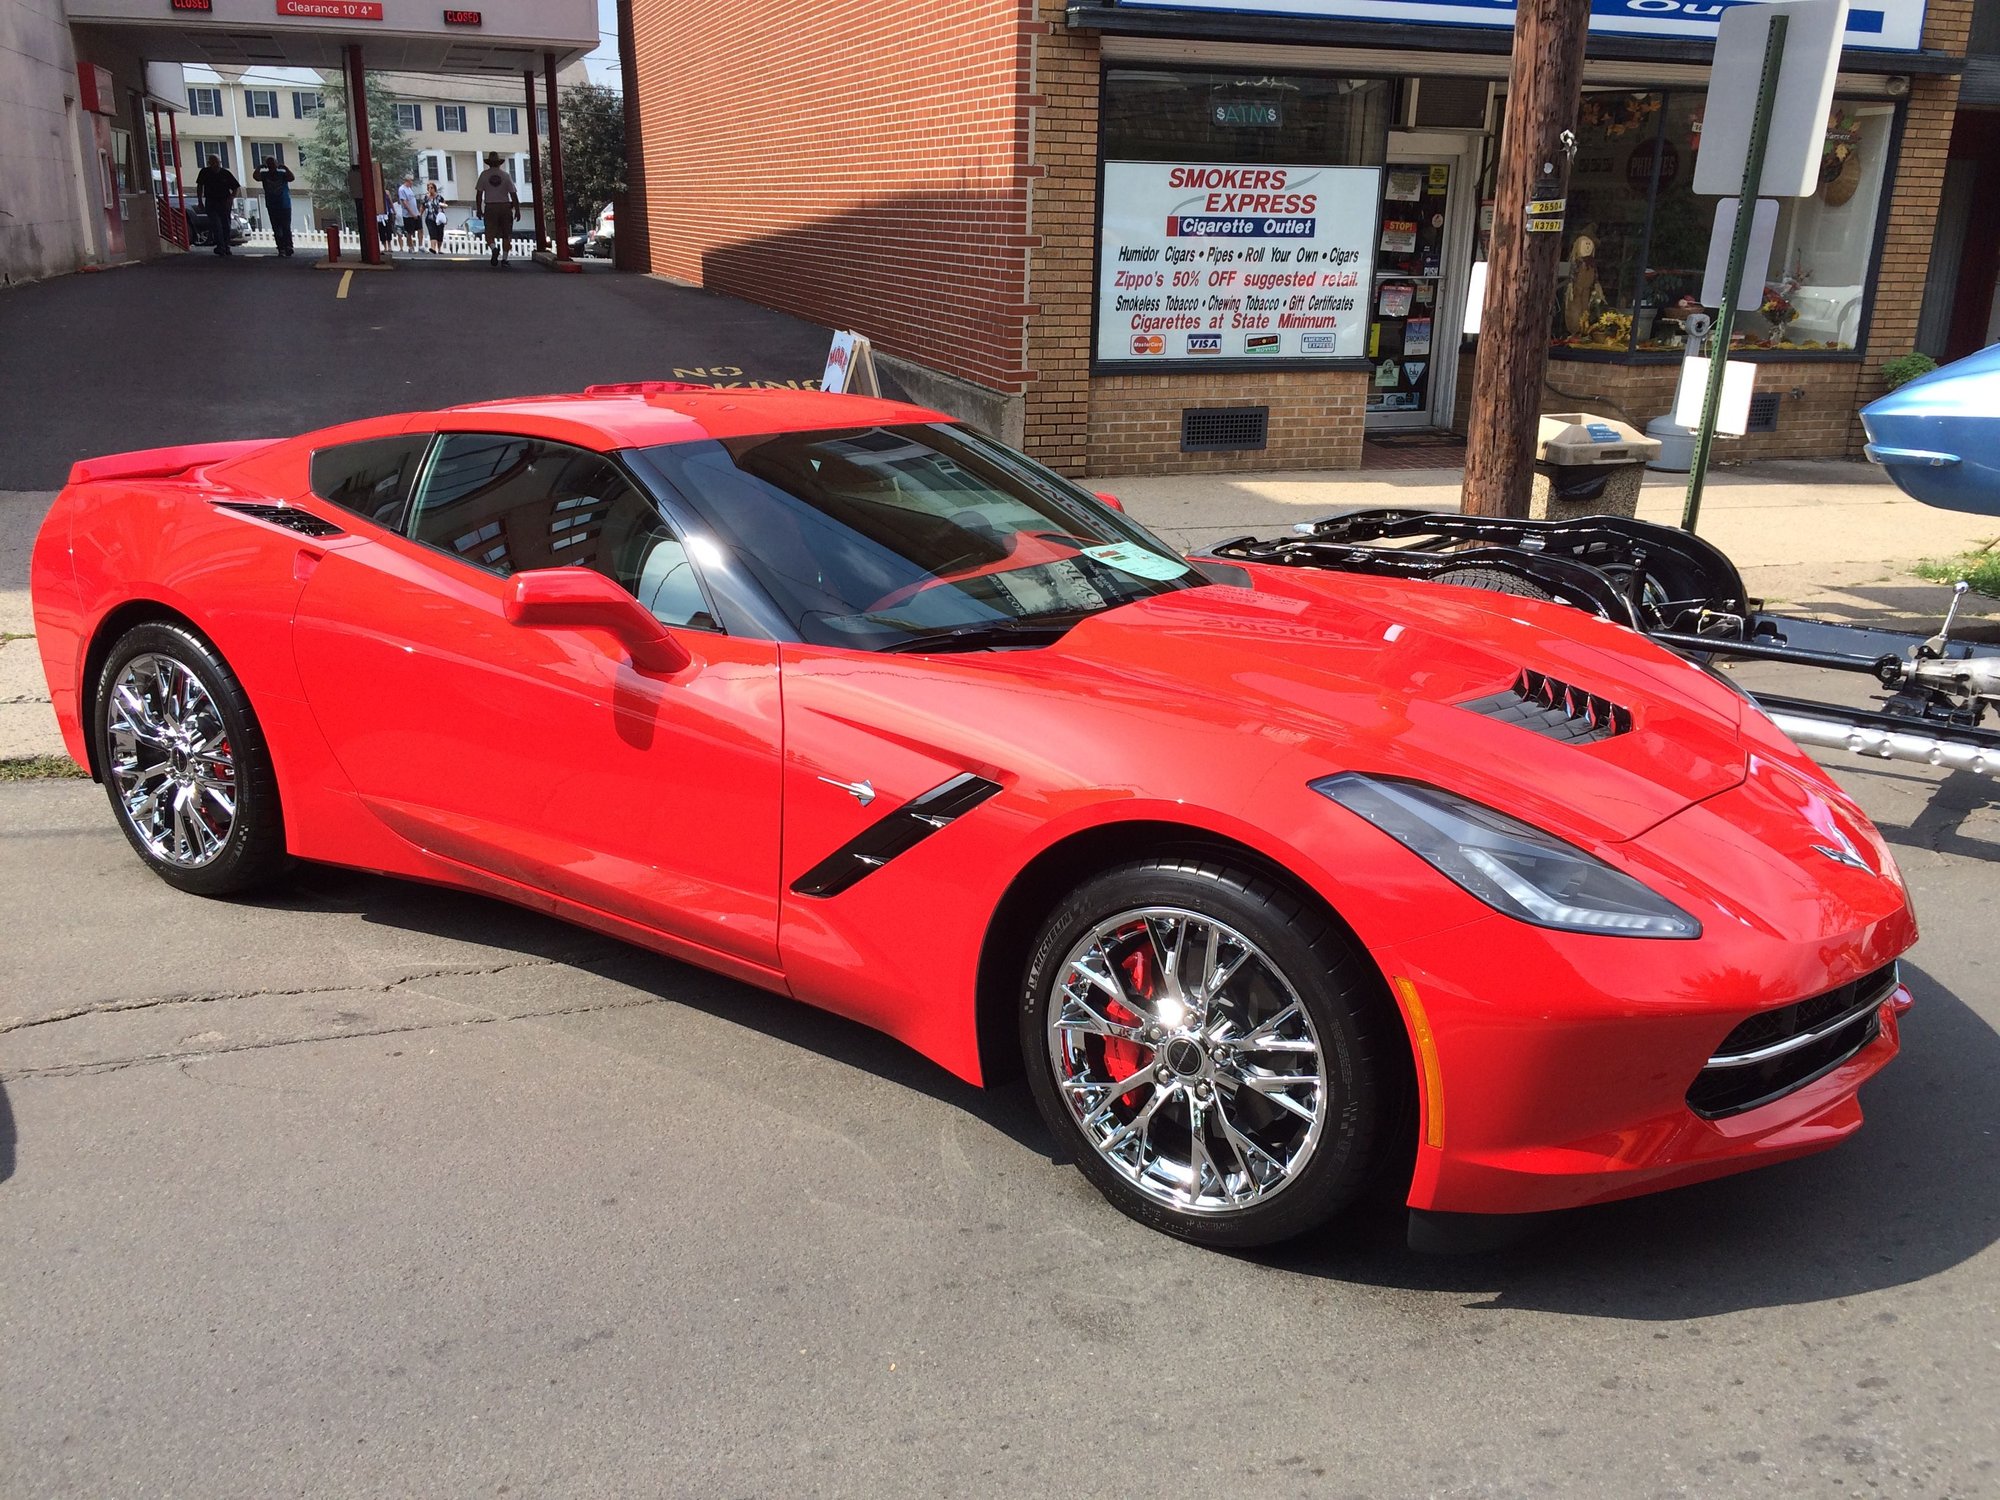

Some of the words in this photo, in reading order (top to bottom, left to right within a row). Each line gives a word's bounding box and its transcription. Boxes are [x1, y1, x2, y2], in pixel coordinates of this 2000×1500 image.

[287, 1, 340, 14] Clearance
[342, 5, 358, 15] 10'
[446, 11, 479, 23] CLOSED
[1168, 167, 1288, 191] SMOKERS
[1205, 193, 1318, 215] EXPRESS
[1182, 218, 1254, 236] Cigarette
[1263, 219, 1312, 234] Outlet
[1389, 221, 1413, 231] STOP!
[1118, 246, 1160, 262] Humidor
[1165, 246, 1196, 266] Cigars
[1206, 246, 1234, 266] Pipes
[1245, 247, 1266, 263] Roll
[1271, 247, 1292, 263] Your
[1296, 247, 1319, 263] Own
[1329, 247, 1360, 266] Cigars
[1114, 270, 1165, 291] Zippo's
[1172, 270, 1201, 287] 50%
[1208, 270, 1238, 287] OFF
[1243, 271, 1317, 290] suggested
[1321, 271, 1359, 287] retail.
[1115, 294, 1161, 312] Smokeless
[1165, 295, 1199, 311] Tobacco
[1208, 294, 1242, 314] Chewing
[1245, 295, 1280, 311] Tobacco
[1288, 294, 1306, 312] Gift
[1308, 294, 1355, 312] Certificates
[1131, 313, 1202, 334] Cigarettes
[1208, 313, 1226, 329] at
[1231, 312, 1270, 329] State
[1277, 313, 1337, 329] Minimum.
[1190, 339, 1218, 349] VISA
[673, 366, 743, 378] NO
[1033, 911, 1073, 972] MICHELIN
